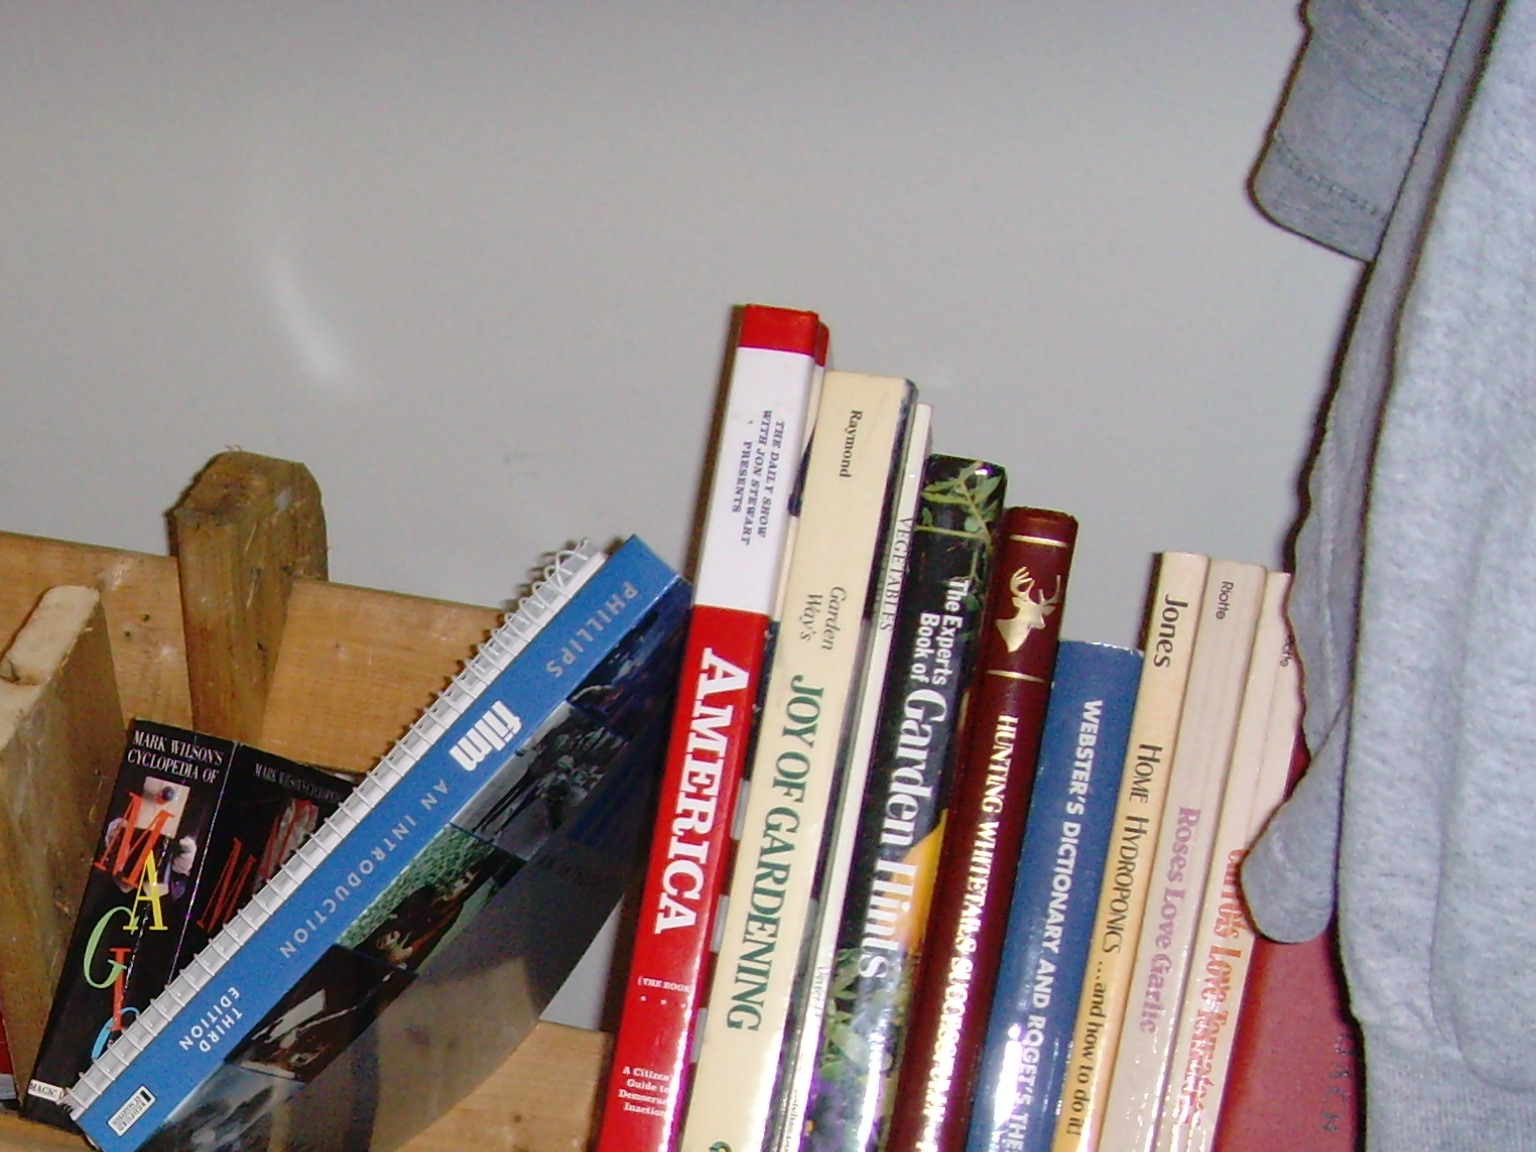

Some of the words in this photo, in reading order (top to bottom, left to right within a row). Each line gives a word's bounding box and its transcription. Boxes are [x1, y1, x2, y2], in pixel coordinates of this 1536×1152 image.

[772, 421, 785, 449] THE
[839, 409, 863, 478] Raymond
[731, 441, 753, 513] PRESENTS
[764, 451, 781, 495] DAILY
[756, 496, 773, 538] SHOW
[545, 581, 639, 679] PHILLIPS
[800, 593, 824, 641] Way's
[822, 586, 848, 651] Garden
[919, 611, 942, 658] Book
[1153, 593, 1189, 668] Jones
[909, 659, 930, 684] of
[448, 700, 523, 772] film
[782, 674, 825, 748] JOY
[127, 748, 200, 780] CYCLOPEDIA
[202, 768, 219, 783] OF
[132, 729, 167, 753] MARK
[170, 738, 224, 765] WILSON'S
[772, 751, 811, 803] OF
[881, 688, 948, 848] Garden
[1066, 699, 1103, 816] WEBSTER'S
[420, 778, 451, 812] AN
[654, 647, 750, 935] AMERICA
[278, 815, 417, 960] INTRODUCTION
[726, 806, 801, 1032] GARDENING
[857, 859, 919, 979] Hints
[1042, 821, 1082, 954] DICTIONARY
[1032, 958, 1058, 1008] AND
[178, 986, 241, 1052] EDITION
[198, 1008, 243, 1053] THIRD
[1018, 1009, 1046, 1106] ROGET'S
